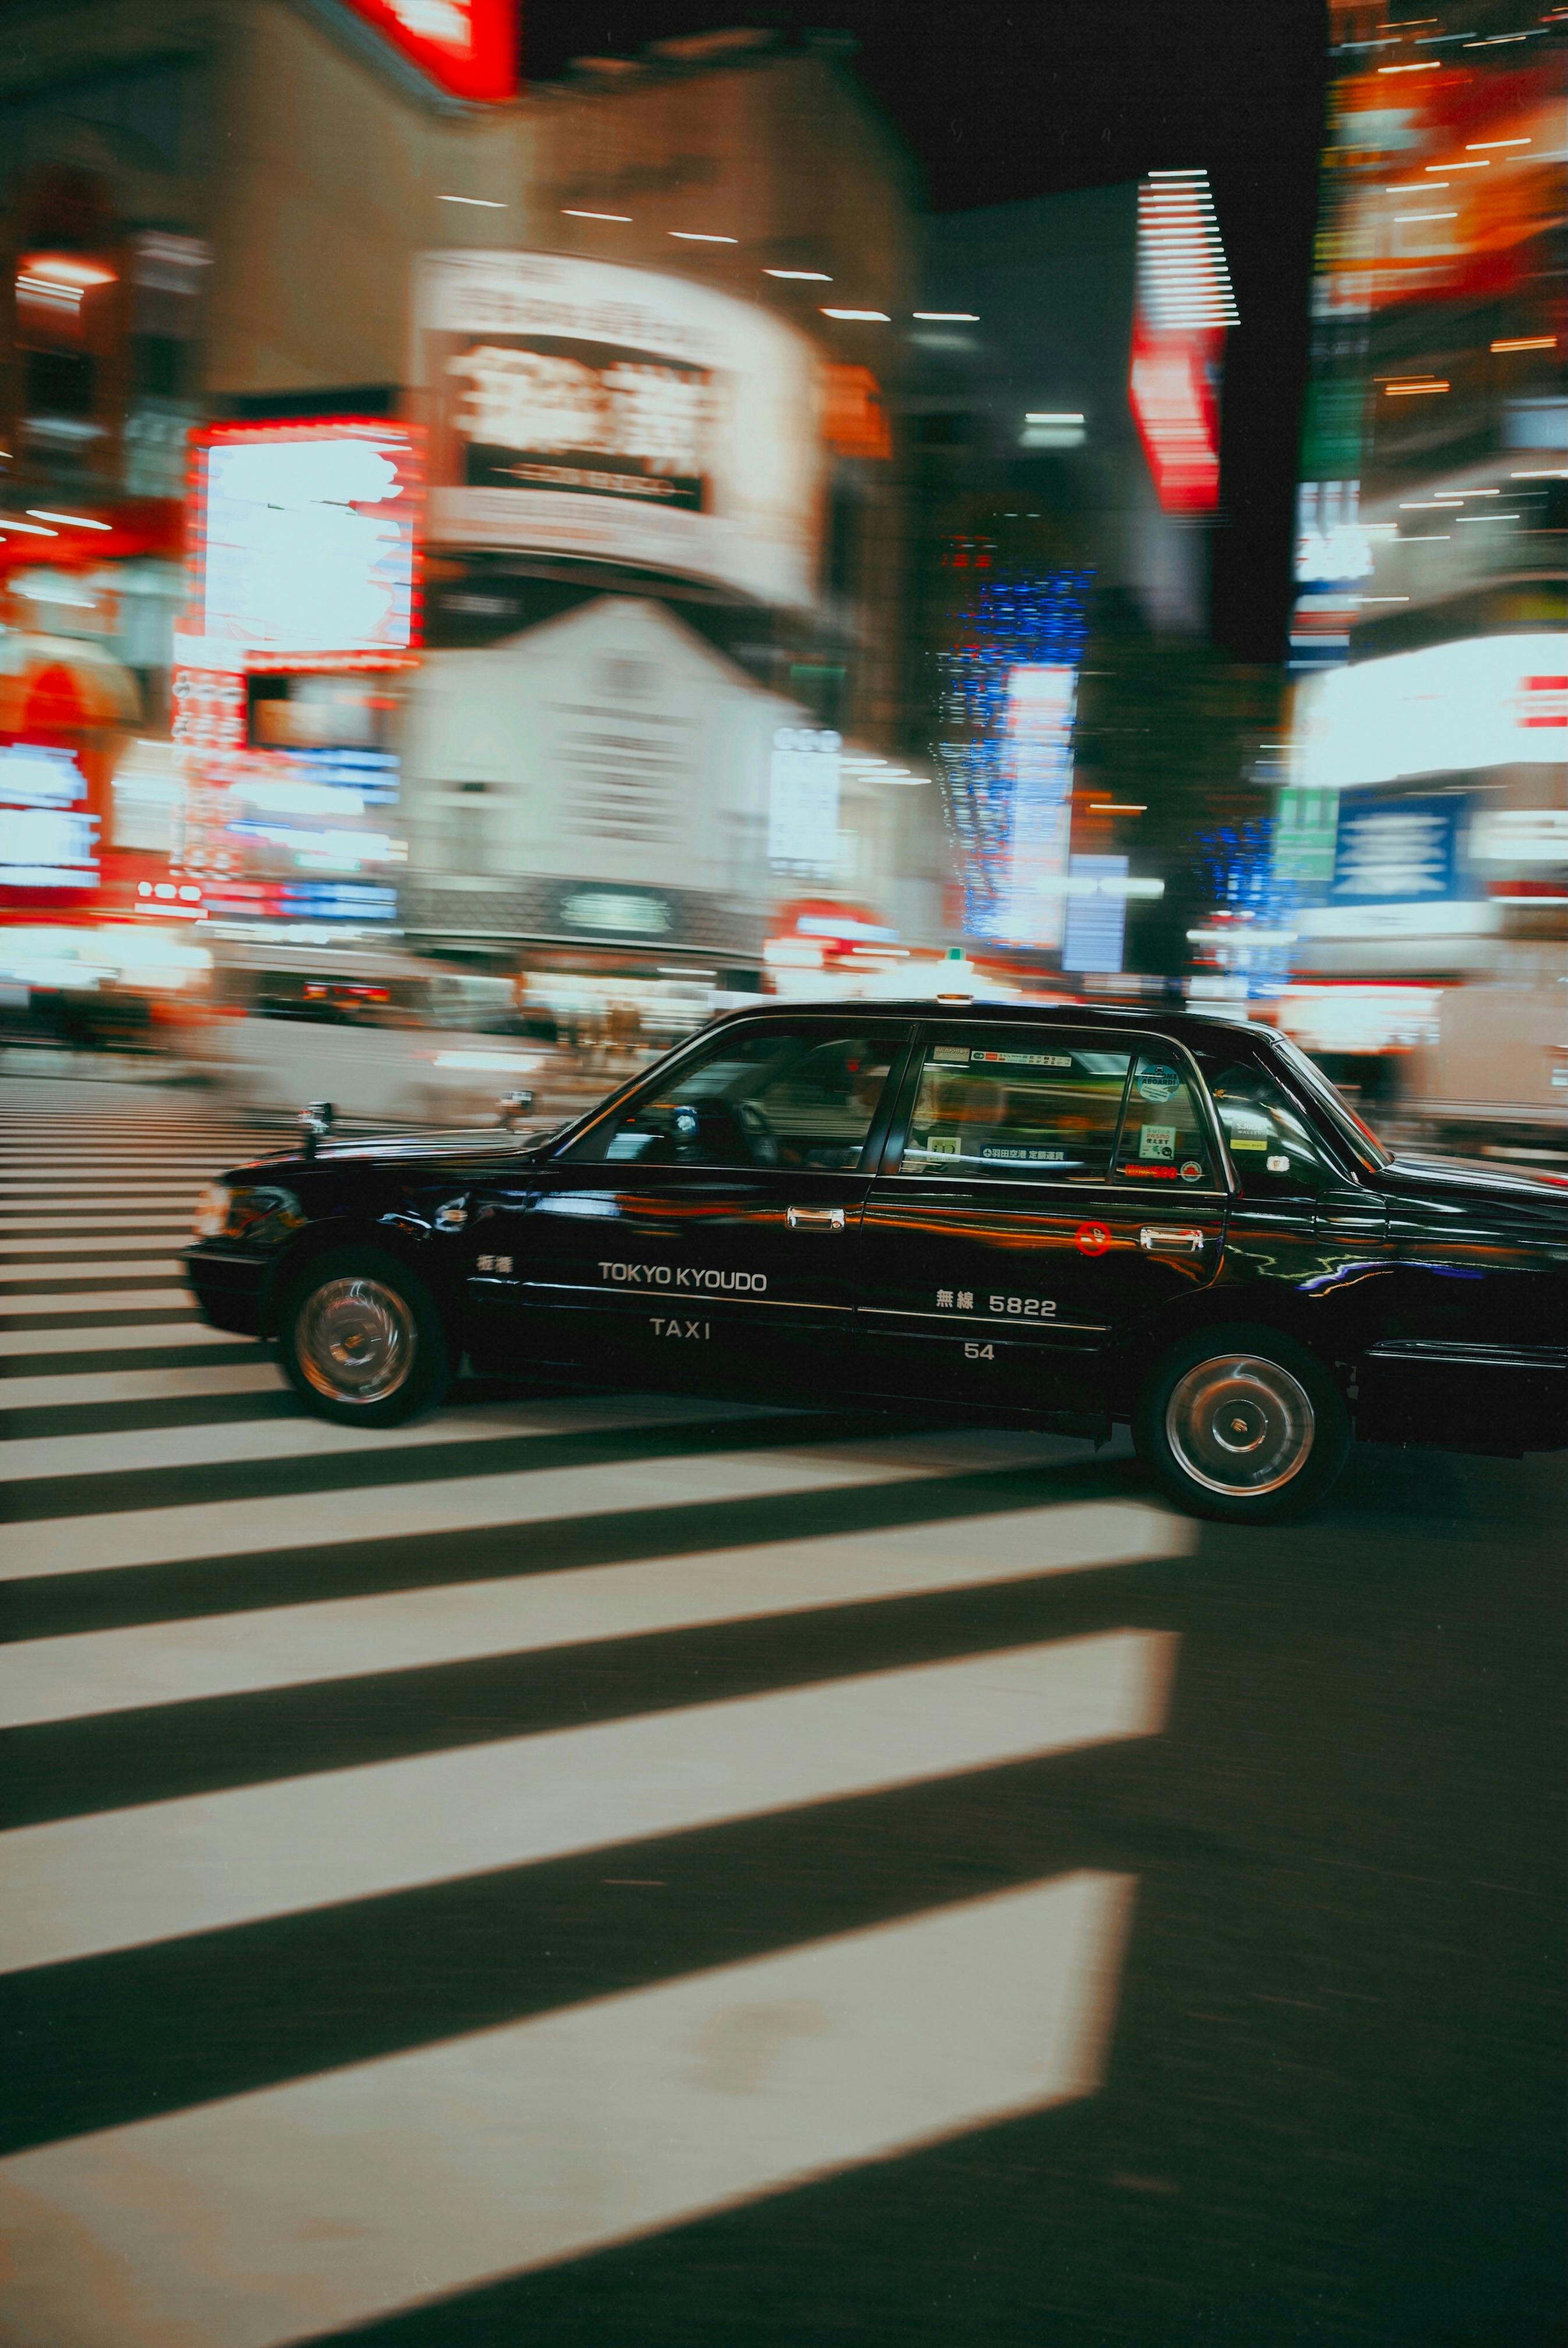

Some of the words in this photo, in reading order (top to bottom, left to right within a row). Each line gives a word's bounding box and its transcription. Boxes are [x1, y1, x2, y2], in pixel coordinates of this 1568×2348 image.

[992, 1148, 1027, 1159] 羽田空港
[1029, 1150, 1064, 1161] 定額運賃
[598, 1261, 671, 1284] TOKYO
[677, 1268, 767, 1292] KYOUDO
[936, 1289, 974, 1310] 無線
[989, 1295, 1057, 1317] 5822
[649, 1318, 710, 1339] TAXI
[964, 1342, 995, 1360] 54
